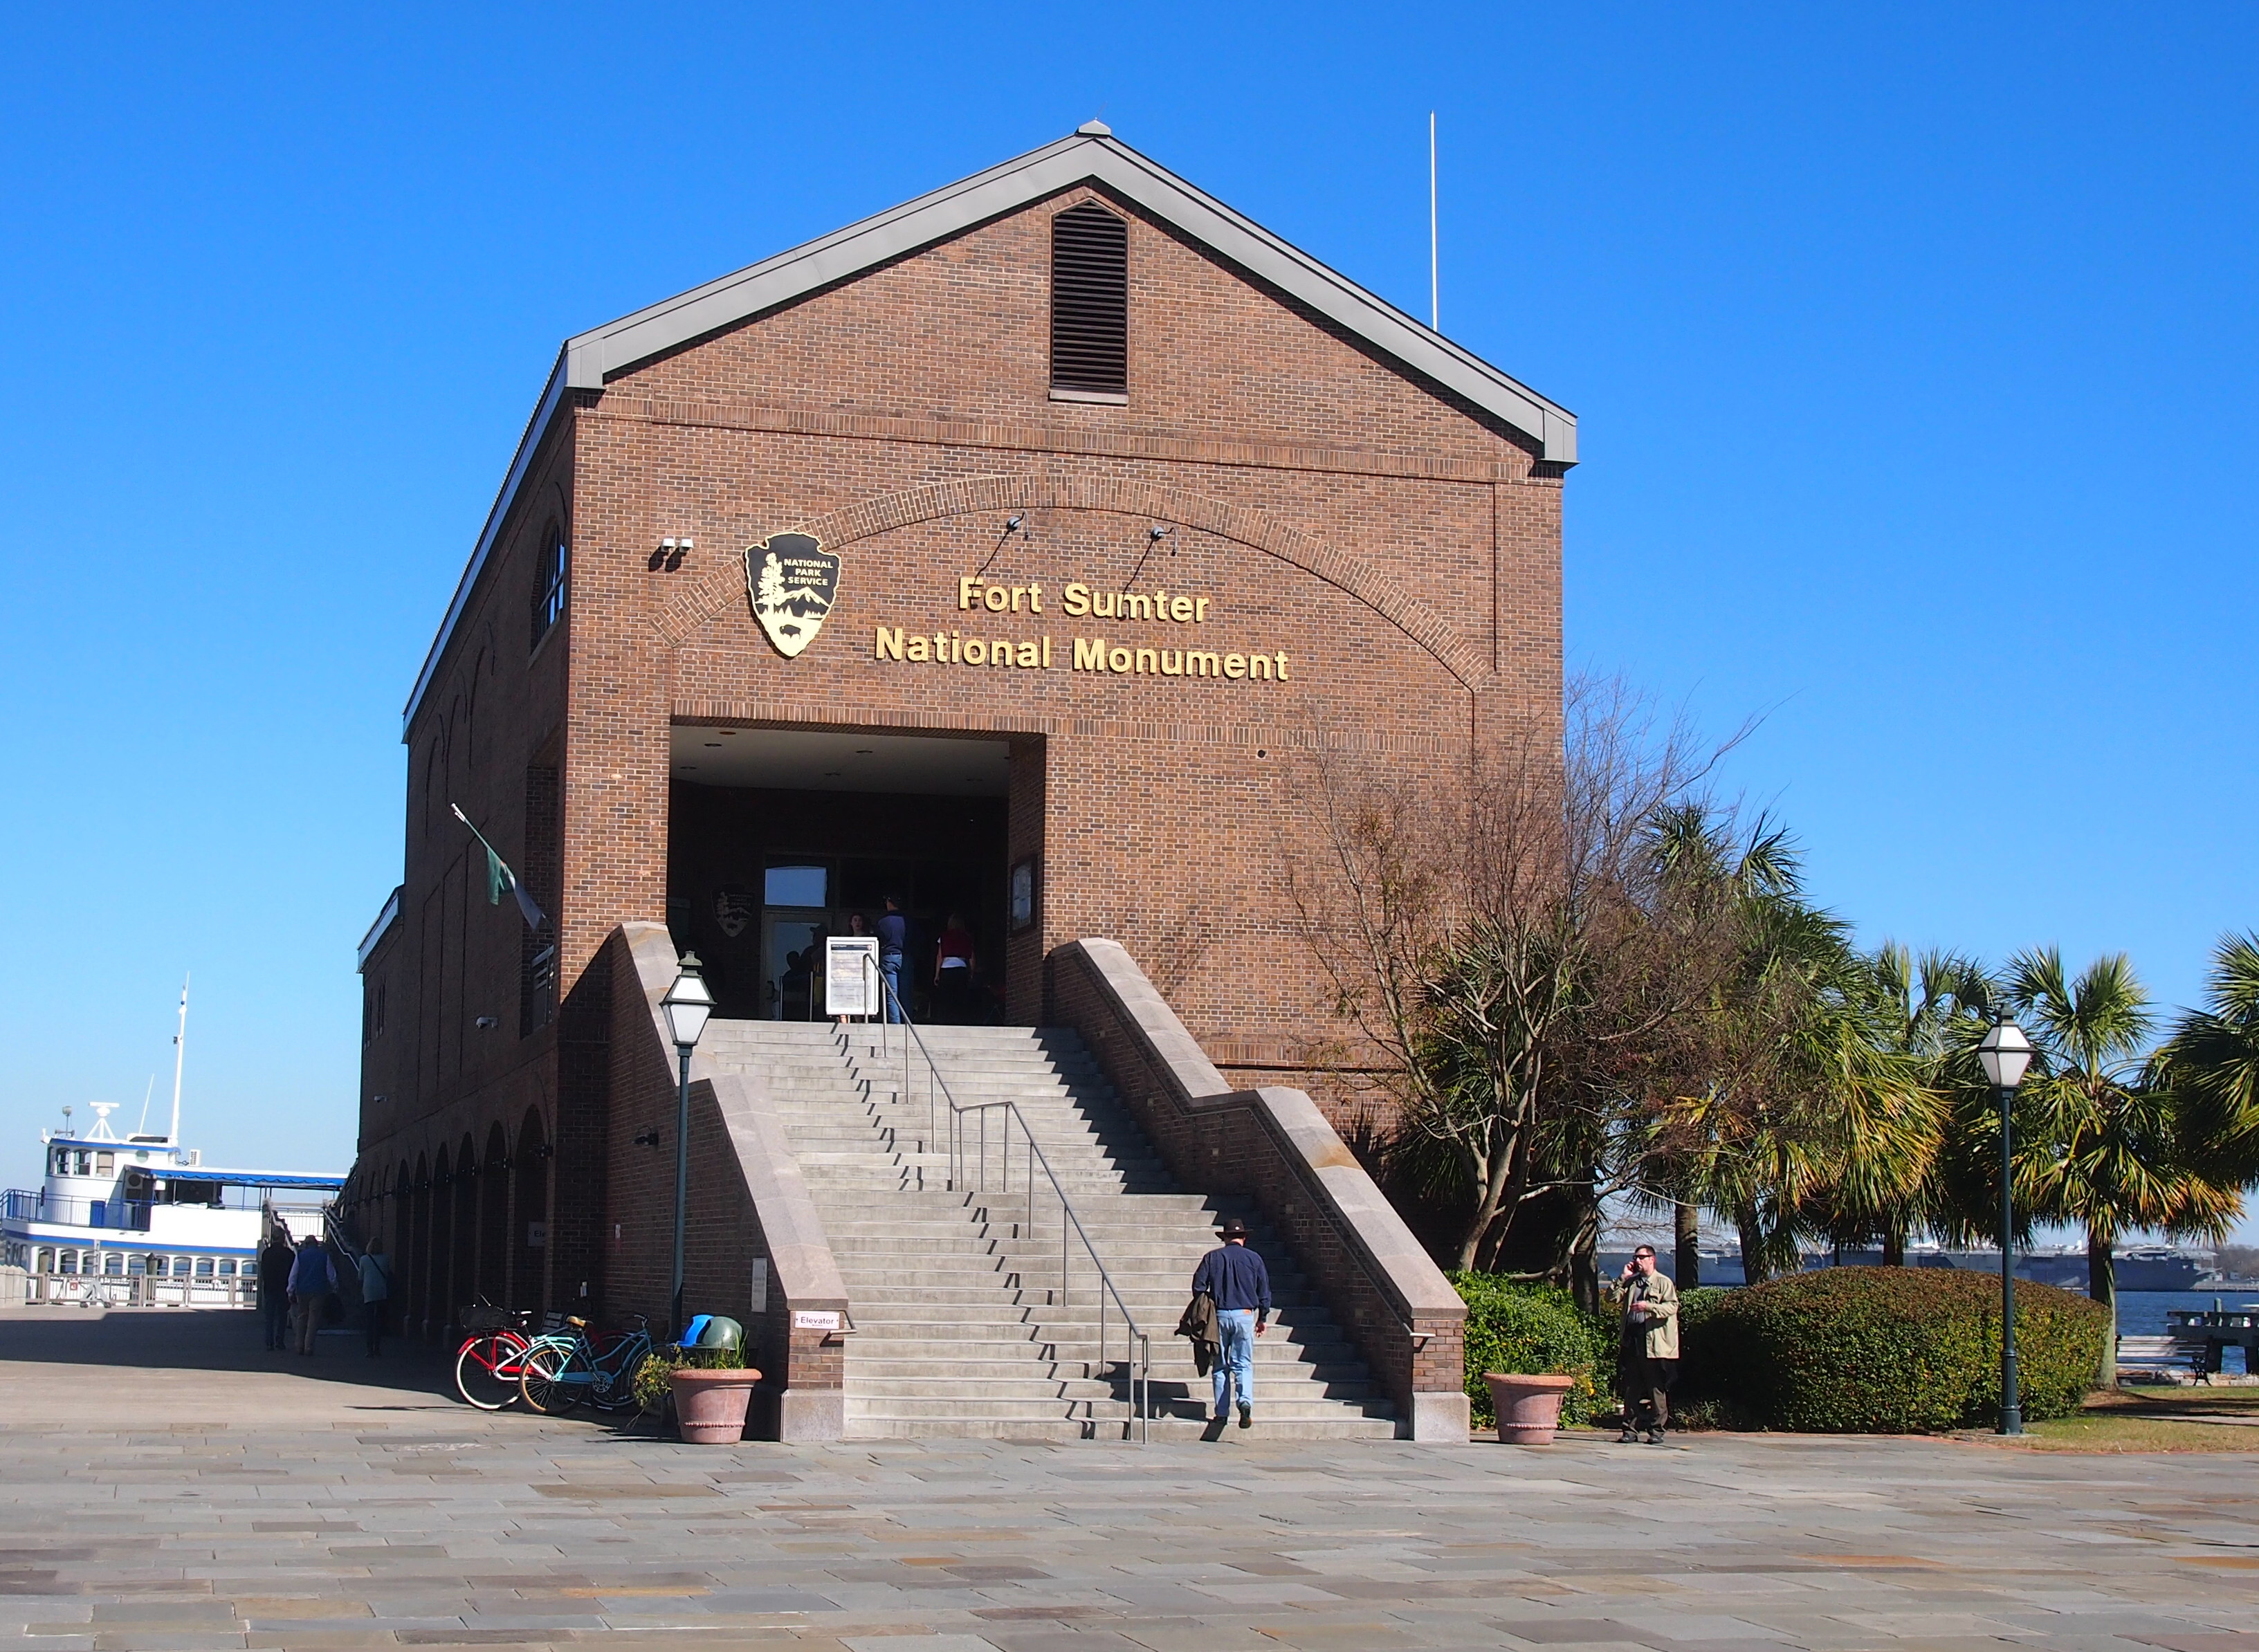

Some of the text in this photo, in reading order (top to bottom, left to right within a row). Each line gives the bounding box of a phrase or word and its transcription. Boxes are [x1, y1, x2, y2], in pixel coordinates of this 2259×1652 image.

[784, 558, 834, 569] NATIONAL
[795, 568, 822, 577] PARK
[787, 576, 829, 586] SERVICE
[959, 577, 1209, 622] Fort Sumter
[875, 626, 1288, 681] National Monument
[801, 1316, 834, 1325] Elevator
